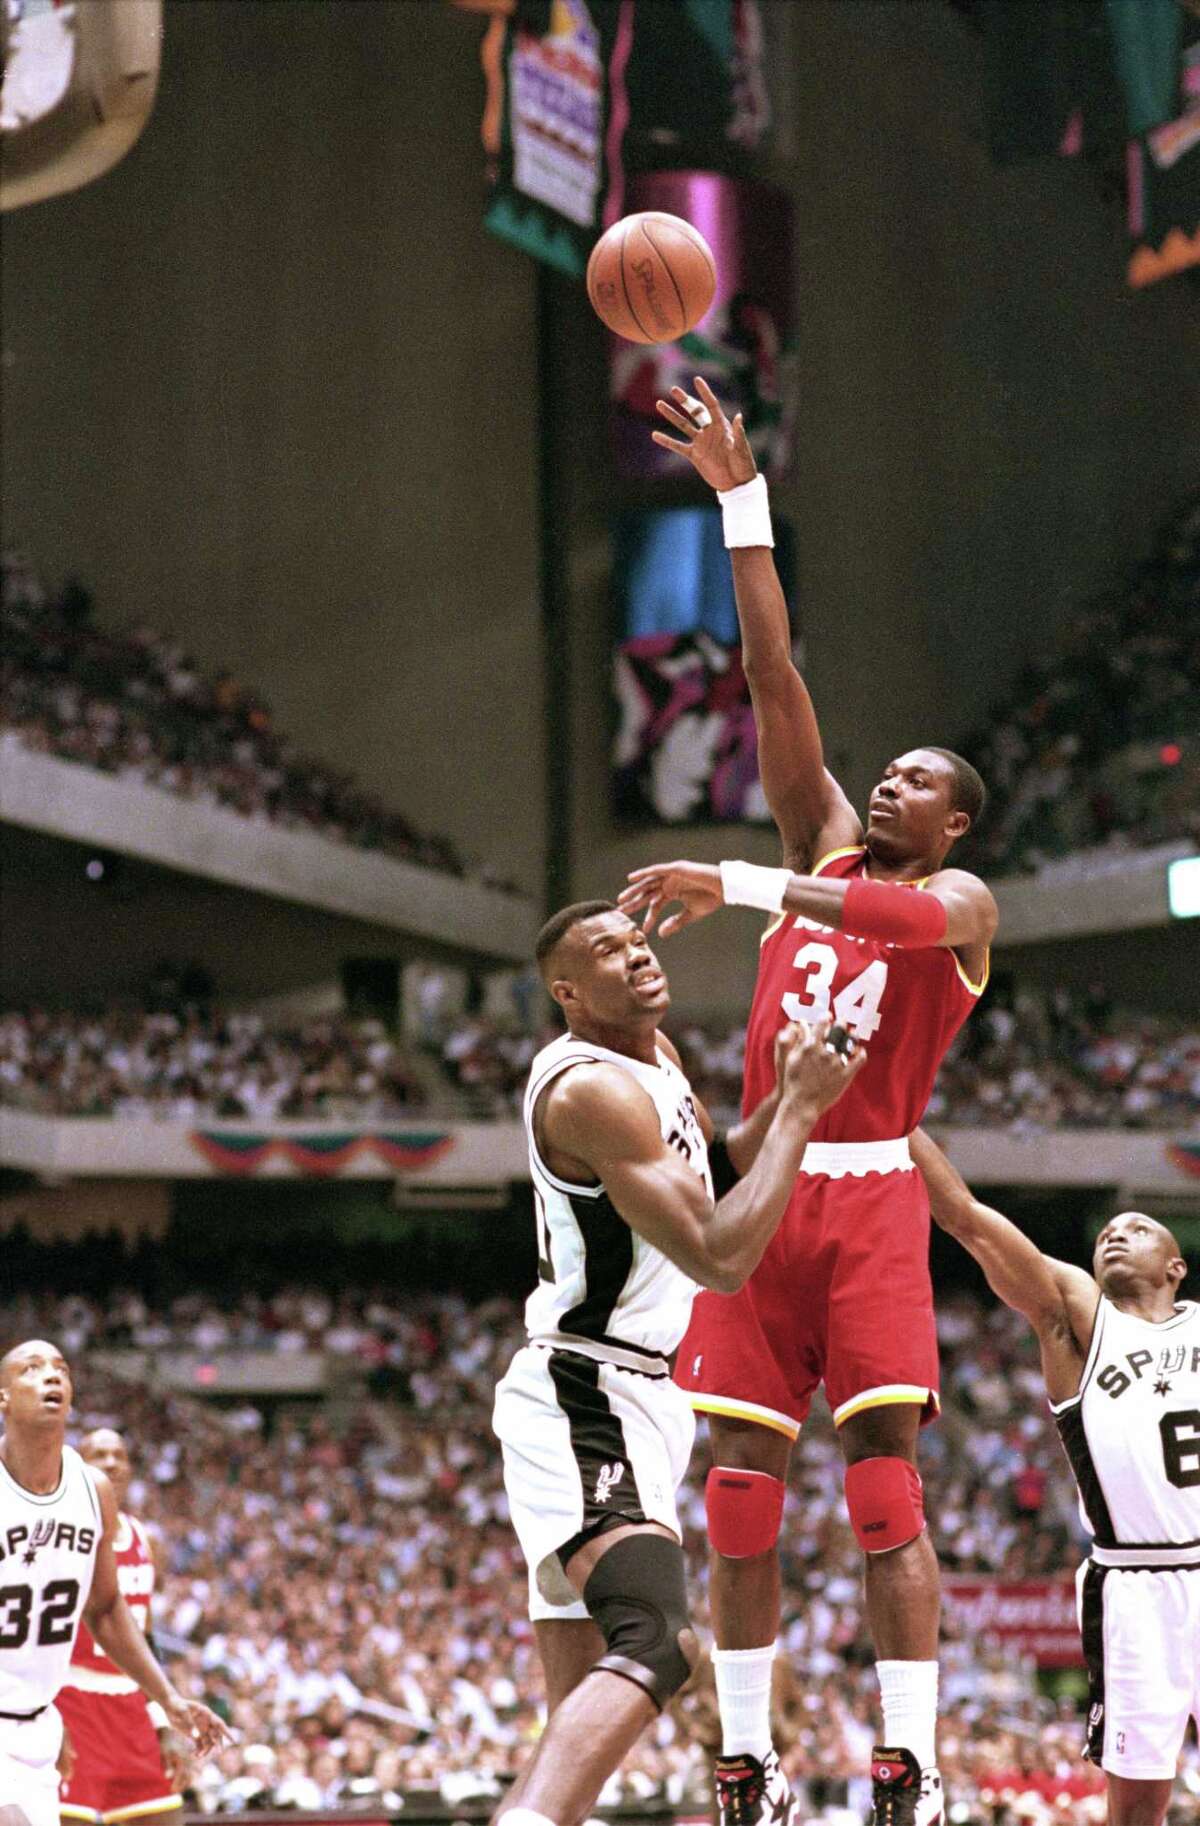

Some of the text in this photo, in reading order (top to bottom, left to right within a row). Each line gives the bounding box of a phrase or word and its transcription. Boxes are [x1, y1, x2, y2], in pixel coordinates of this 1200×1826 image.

[780, 941, 889, 1042] 34
[1158, 1408, 1200, 1490] 6
[0, 1518, 96, 1560] PURS
[0, 1578, 81, 1650] 32
